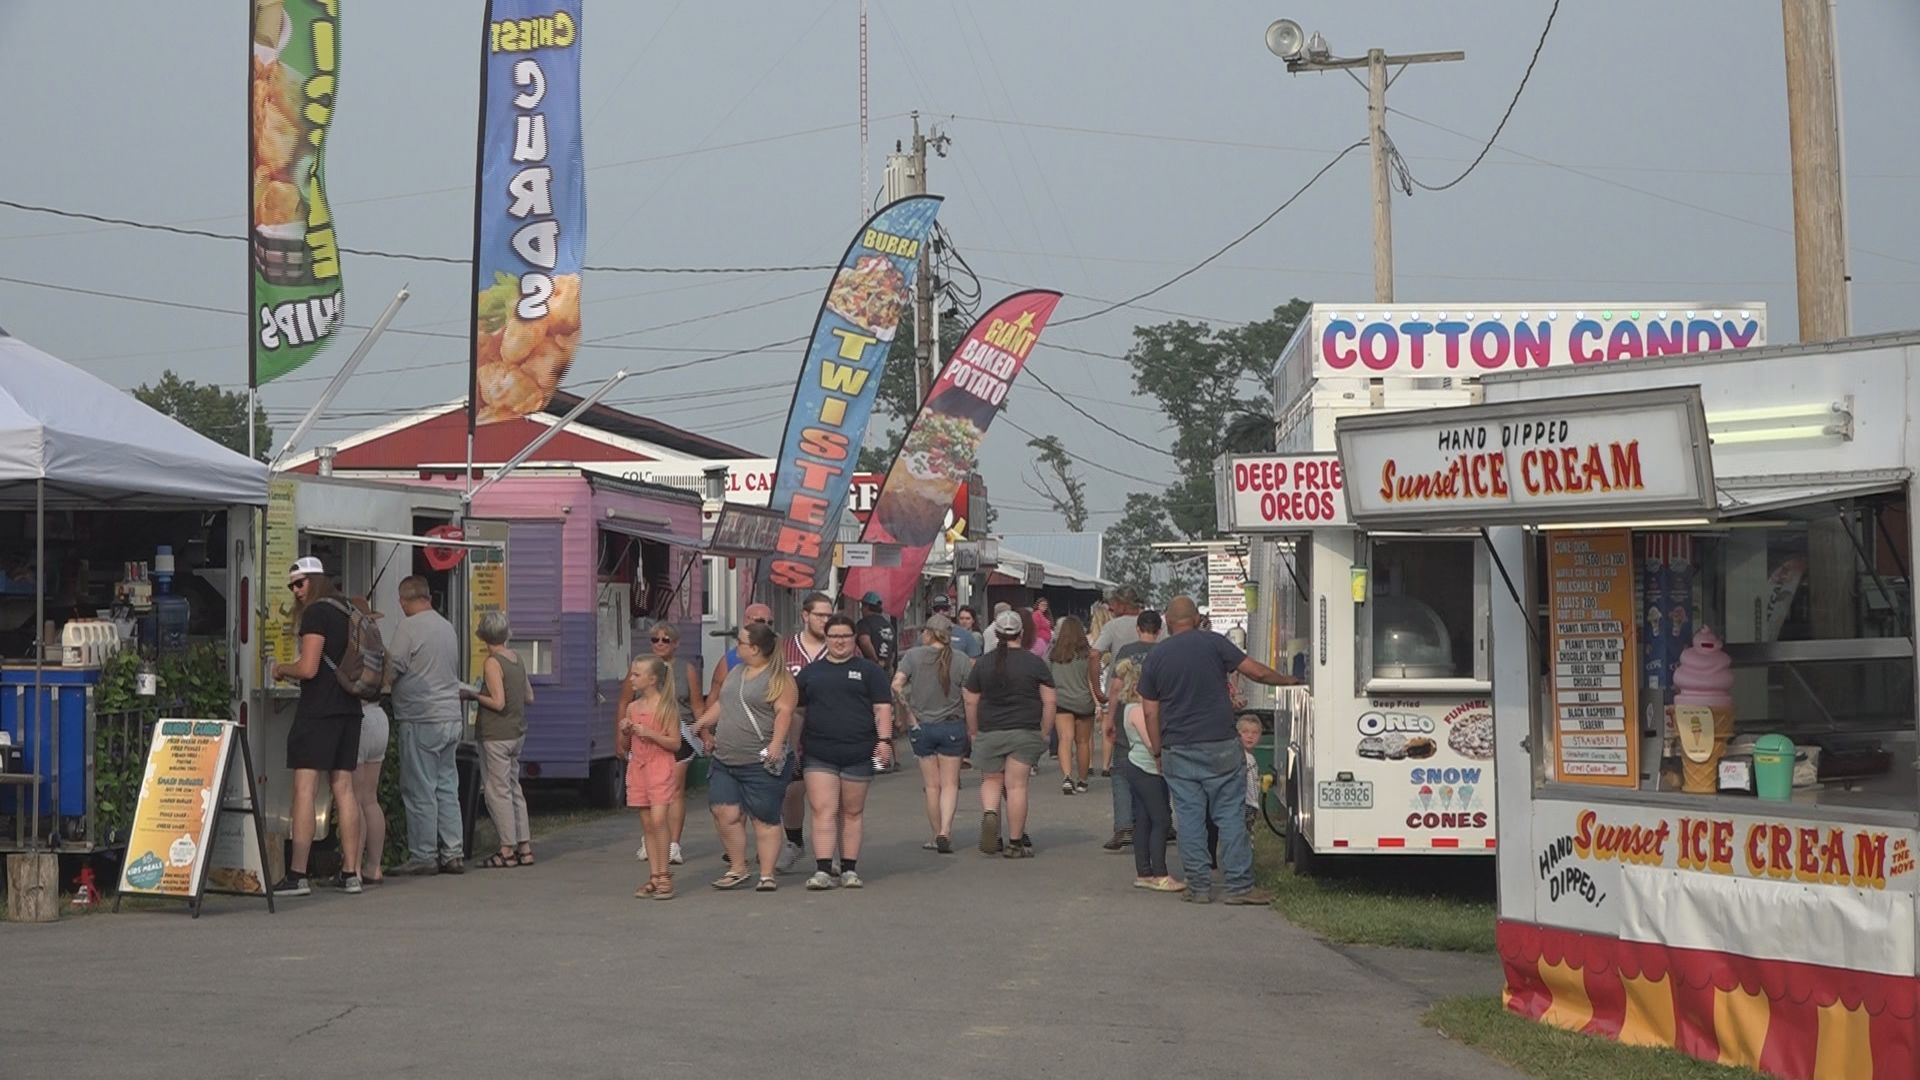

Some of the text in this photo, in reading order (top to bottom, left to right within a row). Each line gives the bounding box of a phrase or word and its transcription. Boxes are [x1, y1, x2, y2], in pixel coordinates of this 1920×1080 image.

[863, 228, 919, 259] BUBBA
[984, 318, 1037, 359] GIANT
[1323, 319, 1758, 370] COTTON CANDY
[960, 338, 1016, 381] BAKED
[943, 359, 1007, 406] POTATO
[1438, 420, 1568, 450] HAND DIPPED
[770, 328, 877, 589] TWISTERS
[1235, 460, 1344, 491] DEEP FRIE
[1380, 438, 1645, 503] Sunset ICE CREAM
[1260, 491, 1336, 521] OREOS
[1558, 623, 1579, 633] PEANUT
[1581, 623, 1600, 633] BUTTER
[1564, 639, 1618, 650] PEANUT BUTTER CUP
[1559, 651, 1619, 662] CHOCOLATE CHIP MINT
[1586, 664, 1606, 674] COOKIE
[1572, 677, 1602, 688] CHOCOLATE
[1372, 700, 1420, 709] Deep Fried
[1578, 692, 1599, 702] VANILLA
[1444, 700, 1489, 725] FUNNEL
[1567, 707, 1616, 718] BLACK RASPBERRY
[1358, 711, 1435, 736] OREO
[1578, 720, 1605, 730] TEABERRY
[1572, 735, 1619, 746] STRAWBERRY
[1410, 767, 1482, 784] SNOW
[1406, 812, 1488, 829] CONES
[1573, 808, 1890, 891] Sunset ICE CREAM
[1893, 838, 1907, 852] ON
[1539, 835, 1573, 880] HAND
[1891, 848, 1910, 863] THE
[1889, 859, 1915, 877] MOVE
